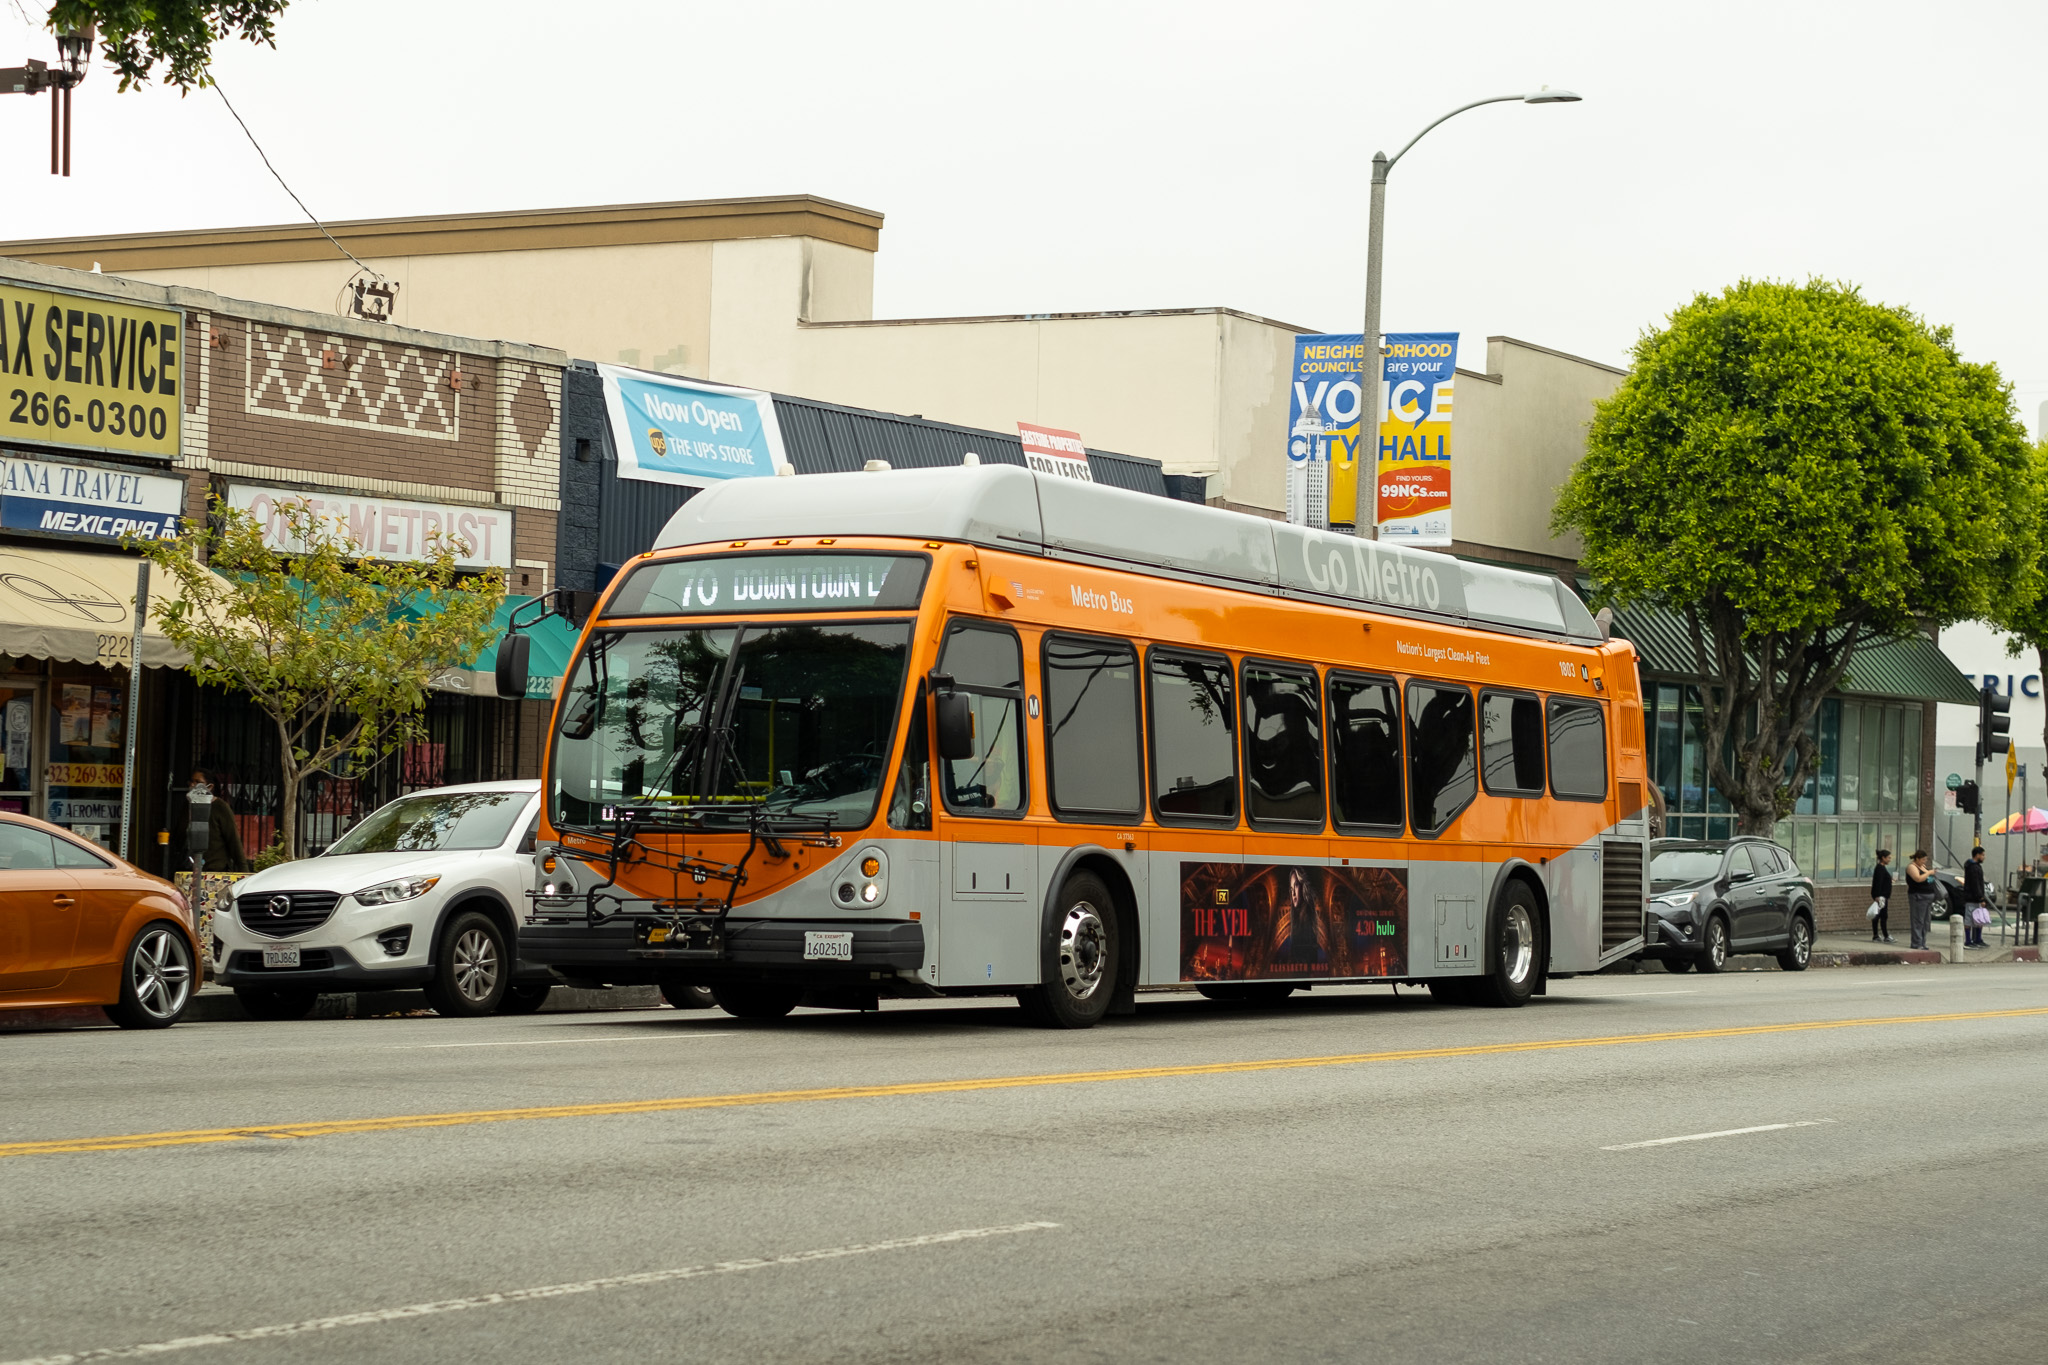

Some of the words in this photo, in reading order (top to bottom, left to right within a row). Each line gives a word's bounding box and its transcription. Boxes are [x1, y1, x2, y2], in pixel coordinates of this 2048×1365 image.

[43, 305, 177, 396] SERVICE
[1300, 361, 1364, 374] COUNCILS
[1387, 362, 1409, 373] are
[1411, 361, 1443, 375] your
[643, 392, 690, 424] Now
[691, 400, 743, 435] Open
[1294, 379, 1456, 423] VOICE
[9, 388, 167, 441] 266-0300
[1324, 420, 1338, 432] at
[651, 436, 666, 453] ups
[668, 437, 692, 457] THE
[694, 441, 717, 460] UPS
[719, 445, 755, 465] STORE
[1287, 434, 1361, 462] CITY
[1378, 435, 1452, 461] HALL
[60, 466, 144, 505] TRAVEL
[1381, 484, 1448, 498] 99NCs.com
[40, 509, 159, 540] MEXICANA
[250, 492, 498, 562] OPTOMETRIST
[1302, 530, 1348, 595] Go
[1352, 539, 1440, 611] Metro
[678, 568, 718, 607] 70
[733, 566, 861, 601] DOWNTOWN
[1070, 584, 1108, 611] Metro
[1111, 590, 1134, 615] Bus
[1396, 639, 1423, 657] Nation's
[1424, 644, 1447, 663] Largest
[1447, 647, 1474, 663] Clean-Air
[1475, 651, 1491, 665] Fleet
[1559, 660, 1576, 678] 1803
[527, 677, 554, 694] 223
[1963, 674, 2039, 698] RIC
[49, 764, 124, 784] 323-269-368
[66, 802, 122, 819] AEROMEXIC
[567, 836, 587, 845] Metro
[1218, 891, 1227, 902] FX
[1191, 908, 1219, 937] THE
[1221, 908, 1252, 937] VEIL
[1355, 920, 1375, 936] 4.30
[1376, 920, 1395, 936] hulu
[807, 942, 849, 956] 1602510
